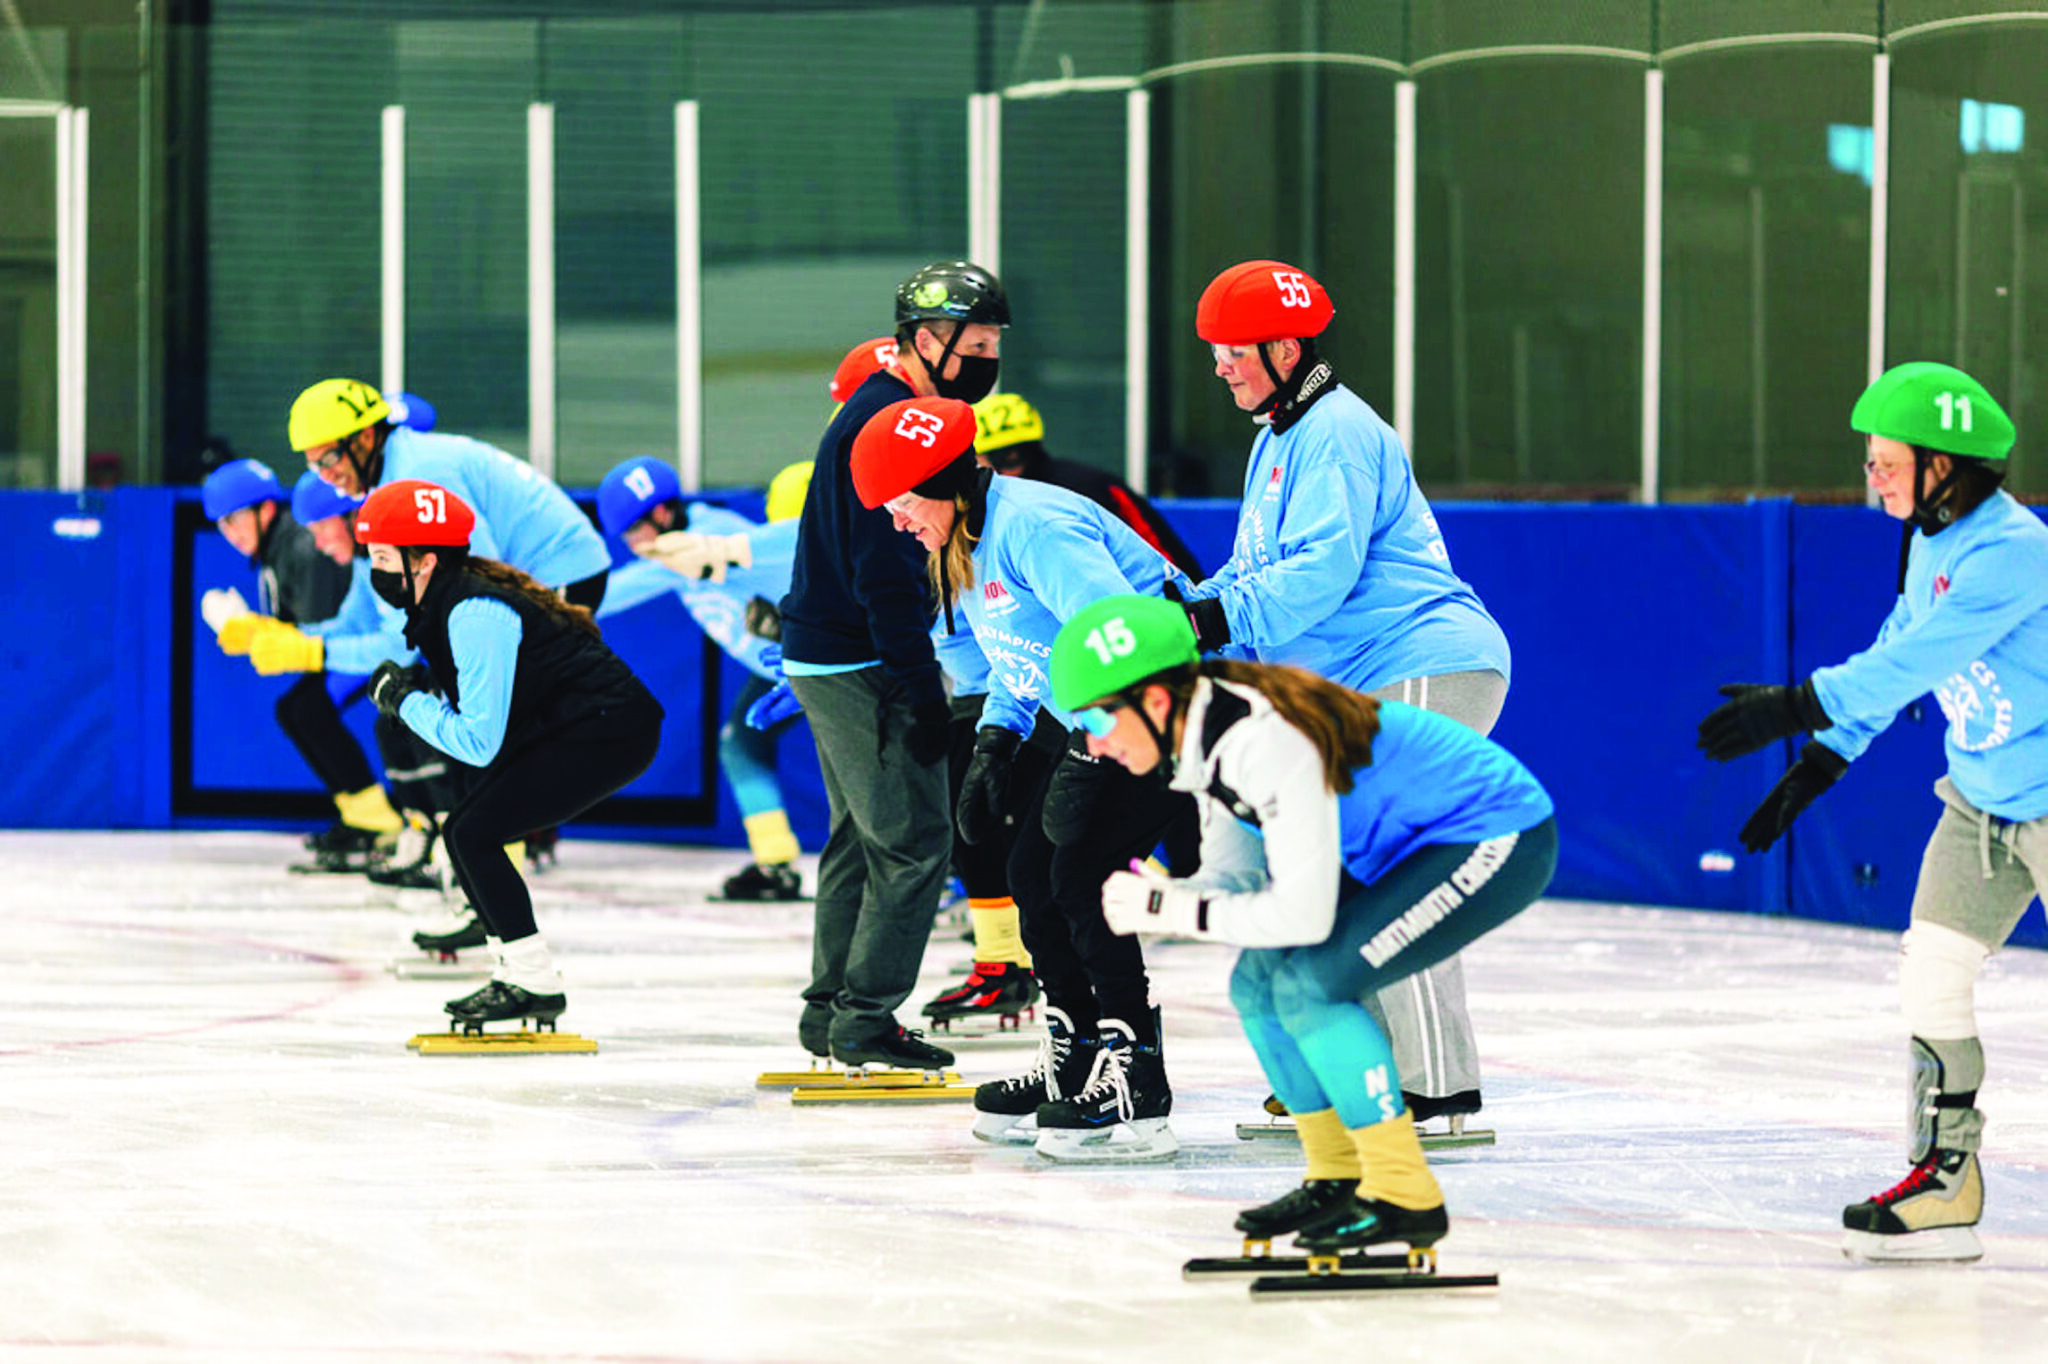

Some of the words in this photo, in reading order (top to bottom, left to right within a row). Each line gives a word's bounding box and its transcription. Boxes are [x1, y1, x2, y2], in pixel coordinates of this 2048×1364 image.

[1272, 271, 1312, 308] 55
[874, 344, 900, 369] 5
[894, 407, 945, 449] 53
[1934, 391, 1973, 433] 11
[414, 488, 448, 524] 57
[1084, 616, 1137, 666] 15
